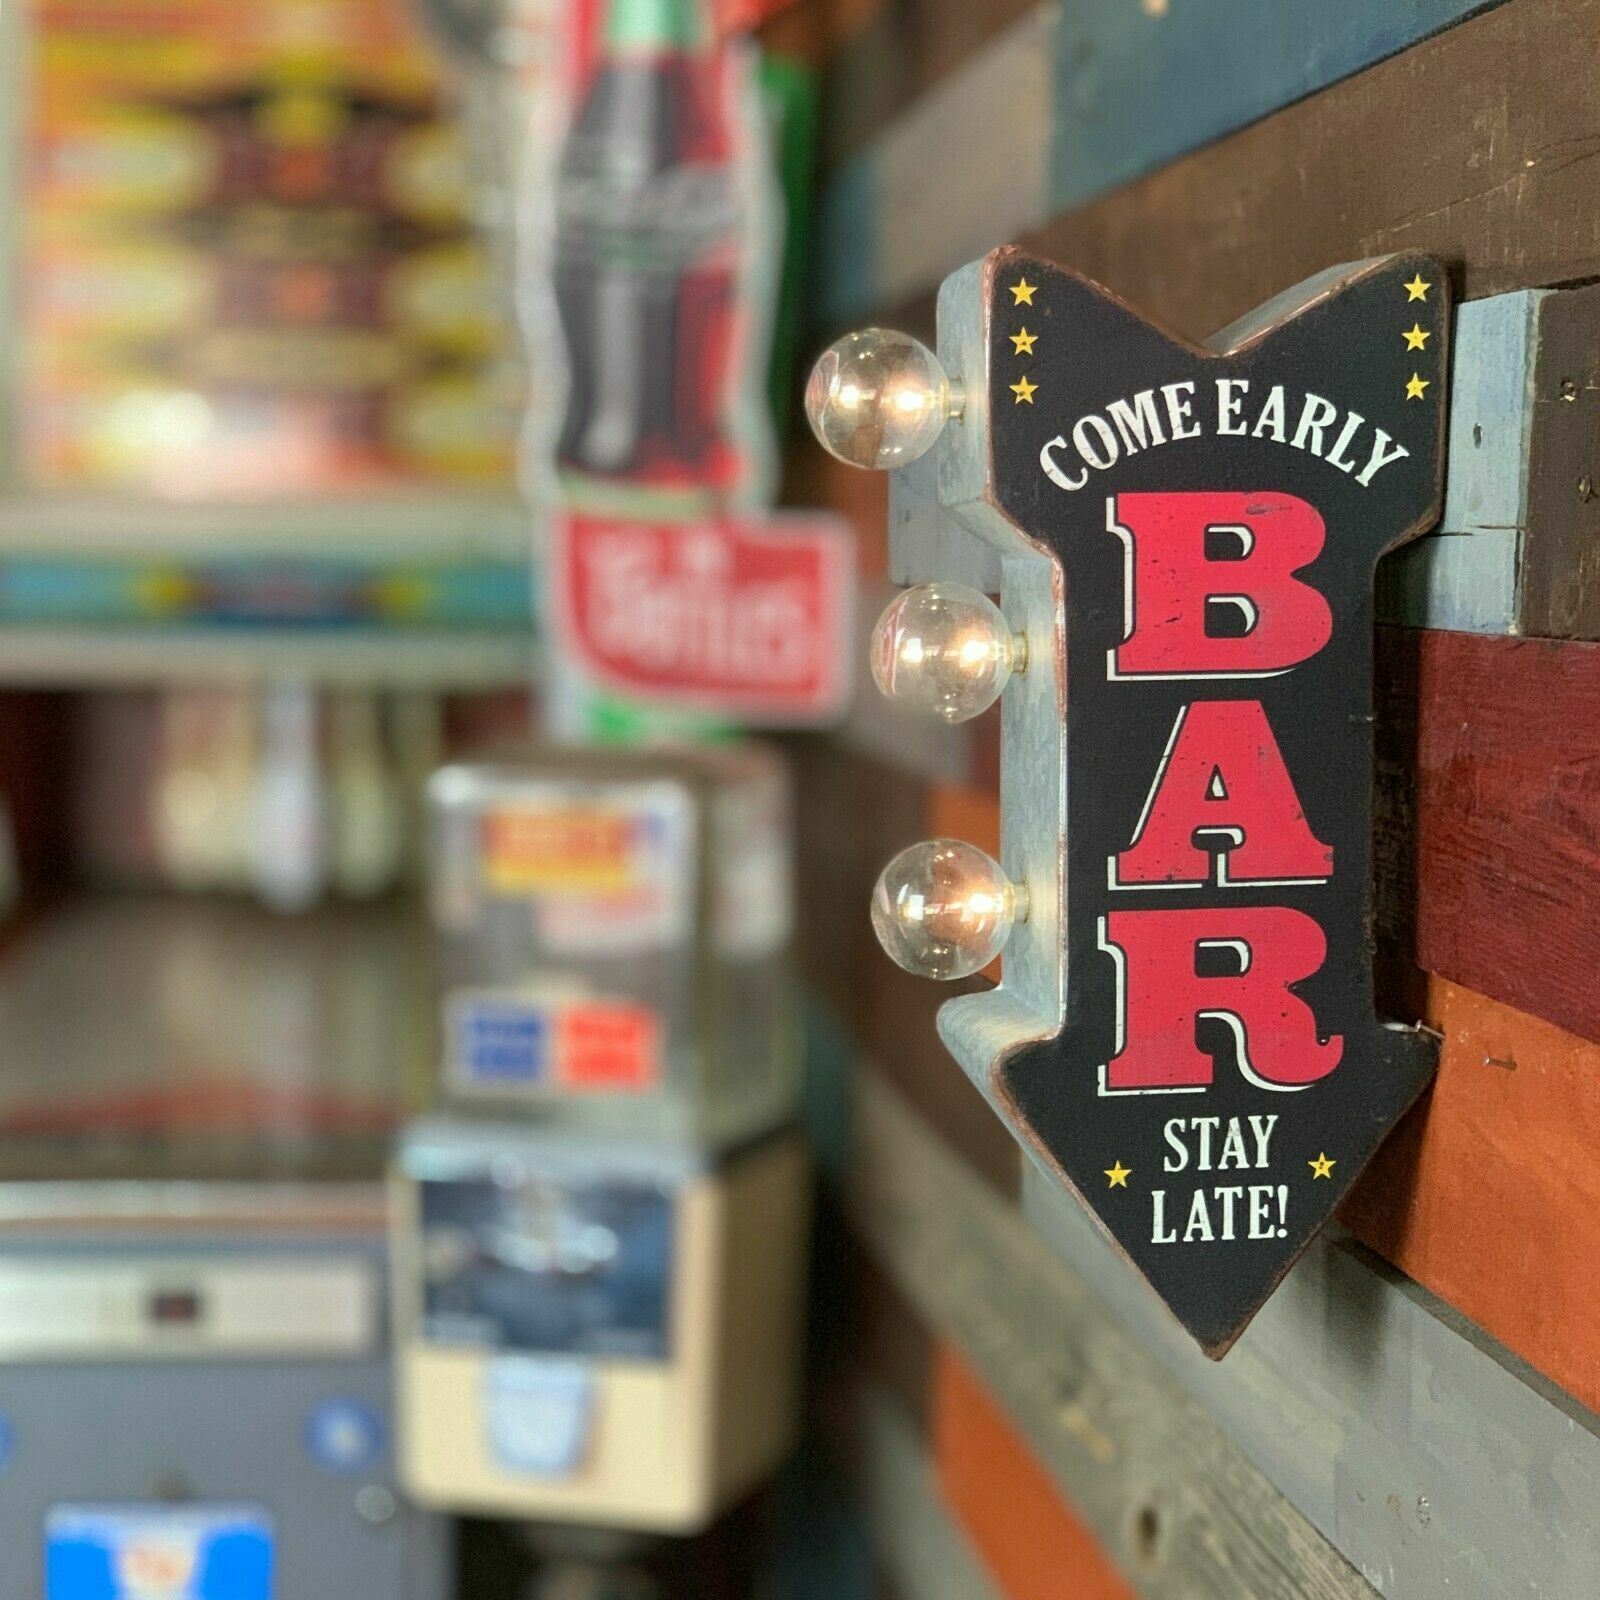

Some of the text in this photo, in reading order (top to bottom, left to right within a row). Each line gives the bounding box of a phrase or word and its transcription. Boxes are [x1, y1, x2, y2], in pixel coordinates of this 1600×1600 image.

[1039, 378, 1409, 491] COME EARLY
[1097, 491, 1344, 1097] BAR
[1163, 1115, 1279, 1173] STAY
[1151, 1186, 1289, 1244] LATE!
